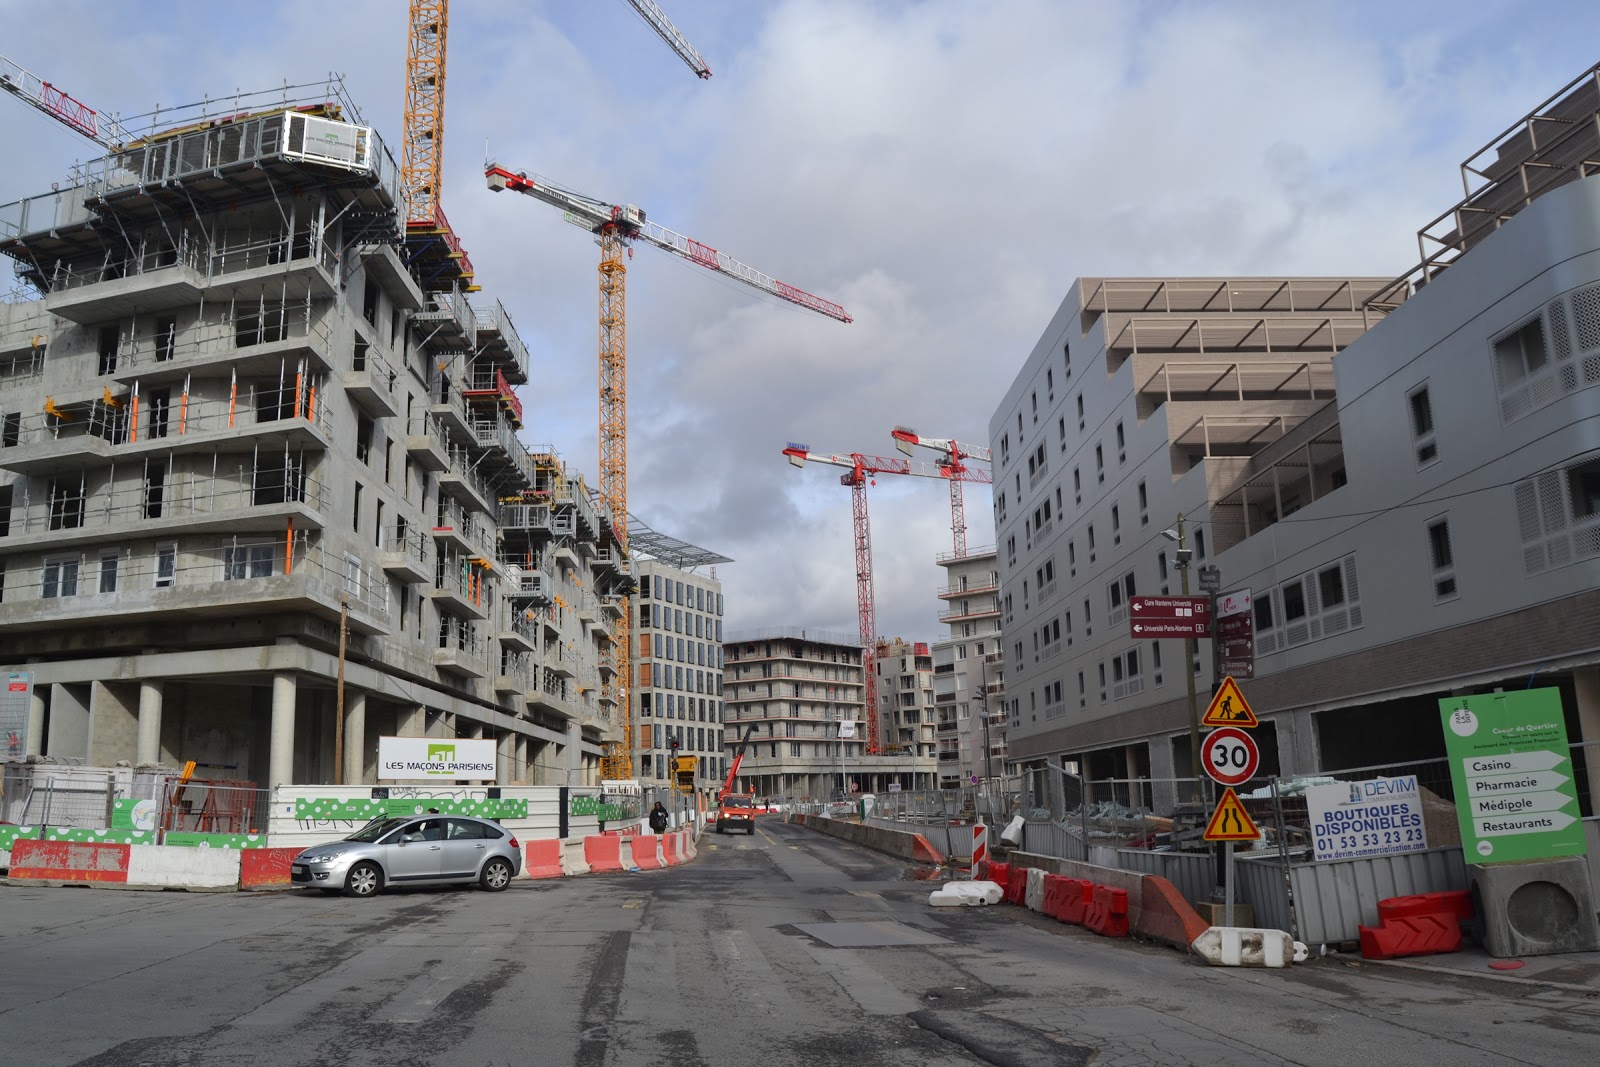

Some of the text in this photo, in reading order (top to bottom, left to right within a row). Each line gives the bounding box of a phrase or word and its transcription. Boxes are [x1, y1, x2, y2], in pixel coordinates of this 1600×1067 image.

[1526, 723, 1558, 732] Quartier
[1214, 744, 1246, 768] 30
[386, 762, 494, 771] LES MAÇONS PARISIENS
[1472, 759, 1511, 772] Casino
[1364, 778, 1415, 796] DEVIM
[1476, 777, 1538, 792] Pharmacie
[1367, 793, 1417, 803] COMMERCIALISATION
[1479, 798, 1533, 813] Médipole
[1324, 804, 1409, 822] BOUTIQUES
[1315, 814, 1421, 836] DISPONIBLES
[1482, 818, 1552, 832] Restaurants
[1318, 829, 1422, 851] 01 53 53 23 23
[1317, 843, 1425, 860] www.devim-commercialisation.com
